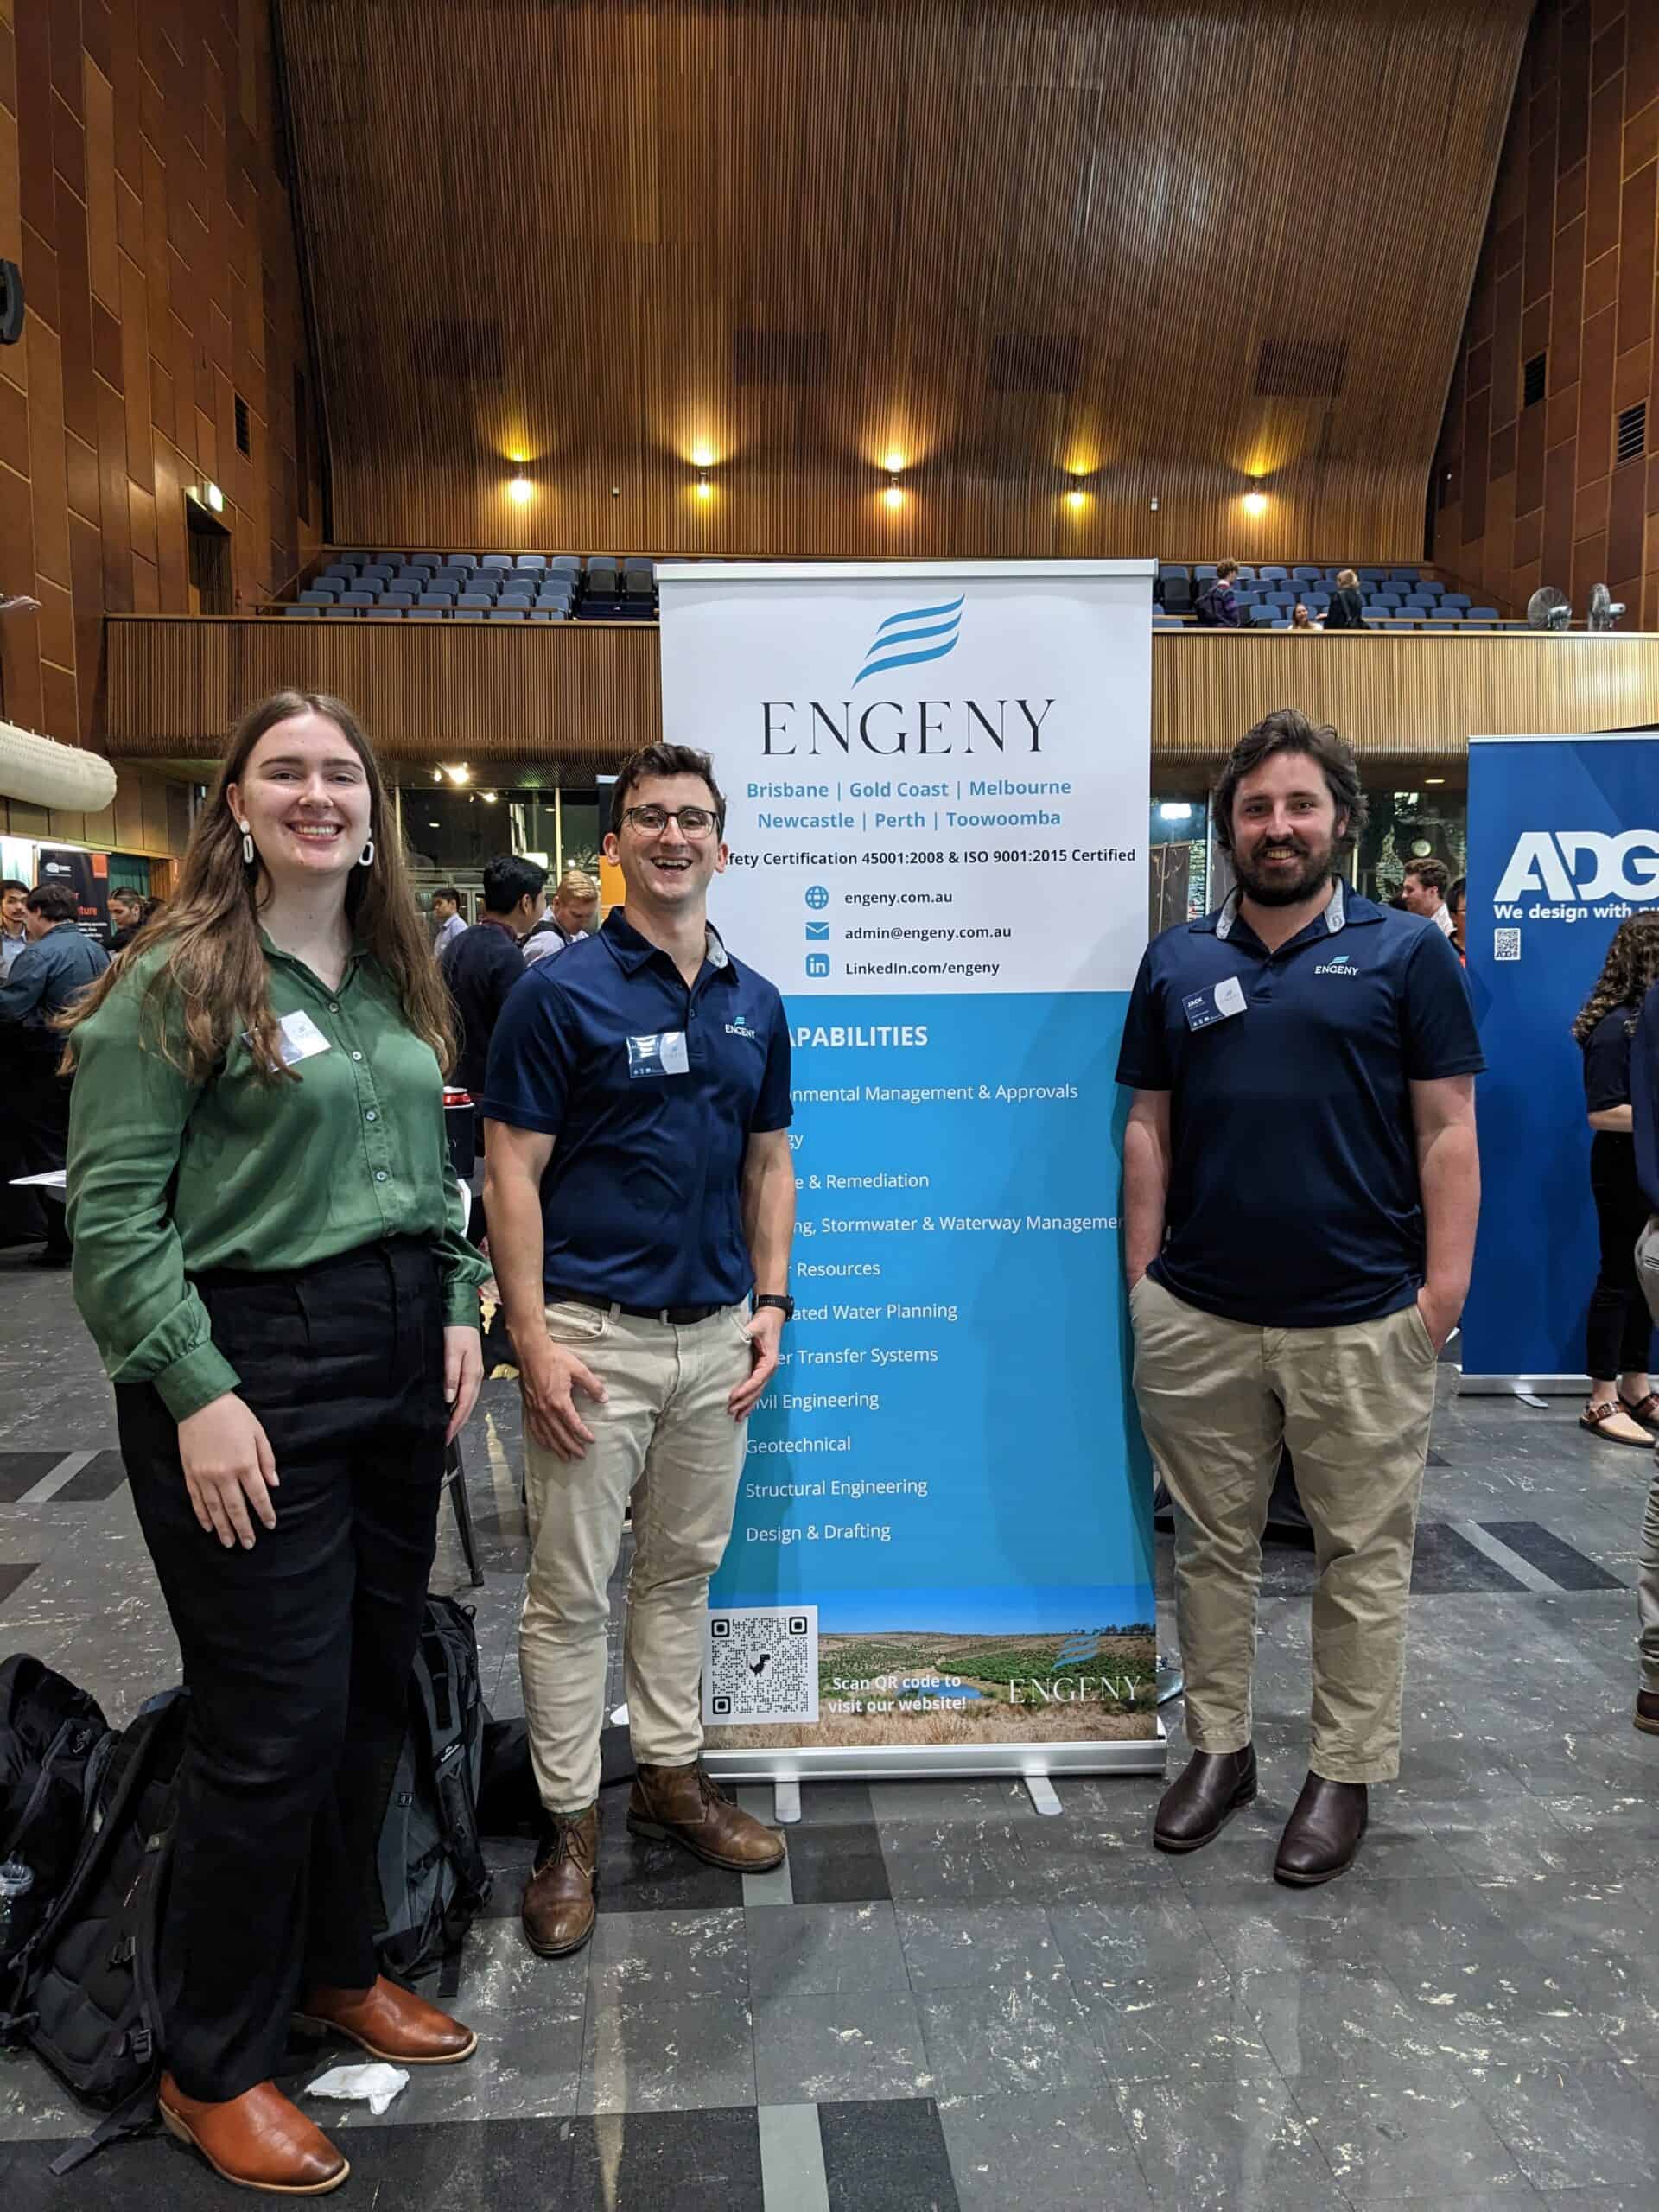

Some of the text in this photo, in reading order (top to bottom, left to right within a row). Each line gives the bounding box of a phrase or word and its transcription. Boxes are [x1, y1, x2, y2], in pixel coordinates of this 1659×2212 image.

[761, 698, 1056, 755] ENGENY
[747, 782, 829, 798] Brisbane
[850, 781, 891, 797] Gold
[898, 783, 949, 797] Coast
[970, 780, 1071, 795] Melbourne
[759, 812, 854, 828] Newcastle
[876, 812, 925, 827] Perth
[947, 810, 1060, 826] Toowoomba
[726, 849, 1135, 868] fety Certification 45001:2008 & ISO 9001:2015 Certified
[1493, 830, 1659, 901] ADG
[845, 893, 952, 906] engeny.com.au
[1493, 904, 1631, 922] We design with
[846, 927, 1011, 941] admin@engeny.com.au
[845, 962, 1000, 976] LinkedIn.com/engeny
[1314, 965, 1359, 975] ENGENY
[789, 1083, 1078, 1103] nmental Management & Approvals
[809, 1175, 822, 1189] &
[826, 1173, 929, 1189] Remediation
[822, 1217, 918, 1233] Stormwater
[923, 1217, 935, 1230] &
[939, 1216, 1021, 1234] Waterway
[797, 1263, 880, 1277] Resources
[833, 1306, 881, 1319] Water
[887, 1303, 957, 1321] Planning
[798, 1348, 867, 1363] Transfer
[872, 1348, 938, 1366] Systems
[754, 1392, 879, 1411] ivil Engineering
[746, 1435, 851, 1453] Geotechnical
[747, 1479, 927, 1497] Structural Engineering
[747, 1523, 892, 1544] Design & Drafting
[832, 1674, 961, 1694] Scan QR code to
[1009, 1676, 1141, 1704] ENGENY
[830, 1695, 966, 1713] visit our website!
